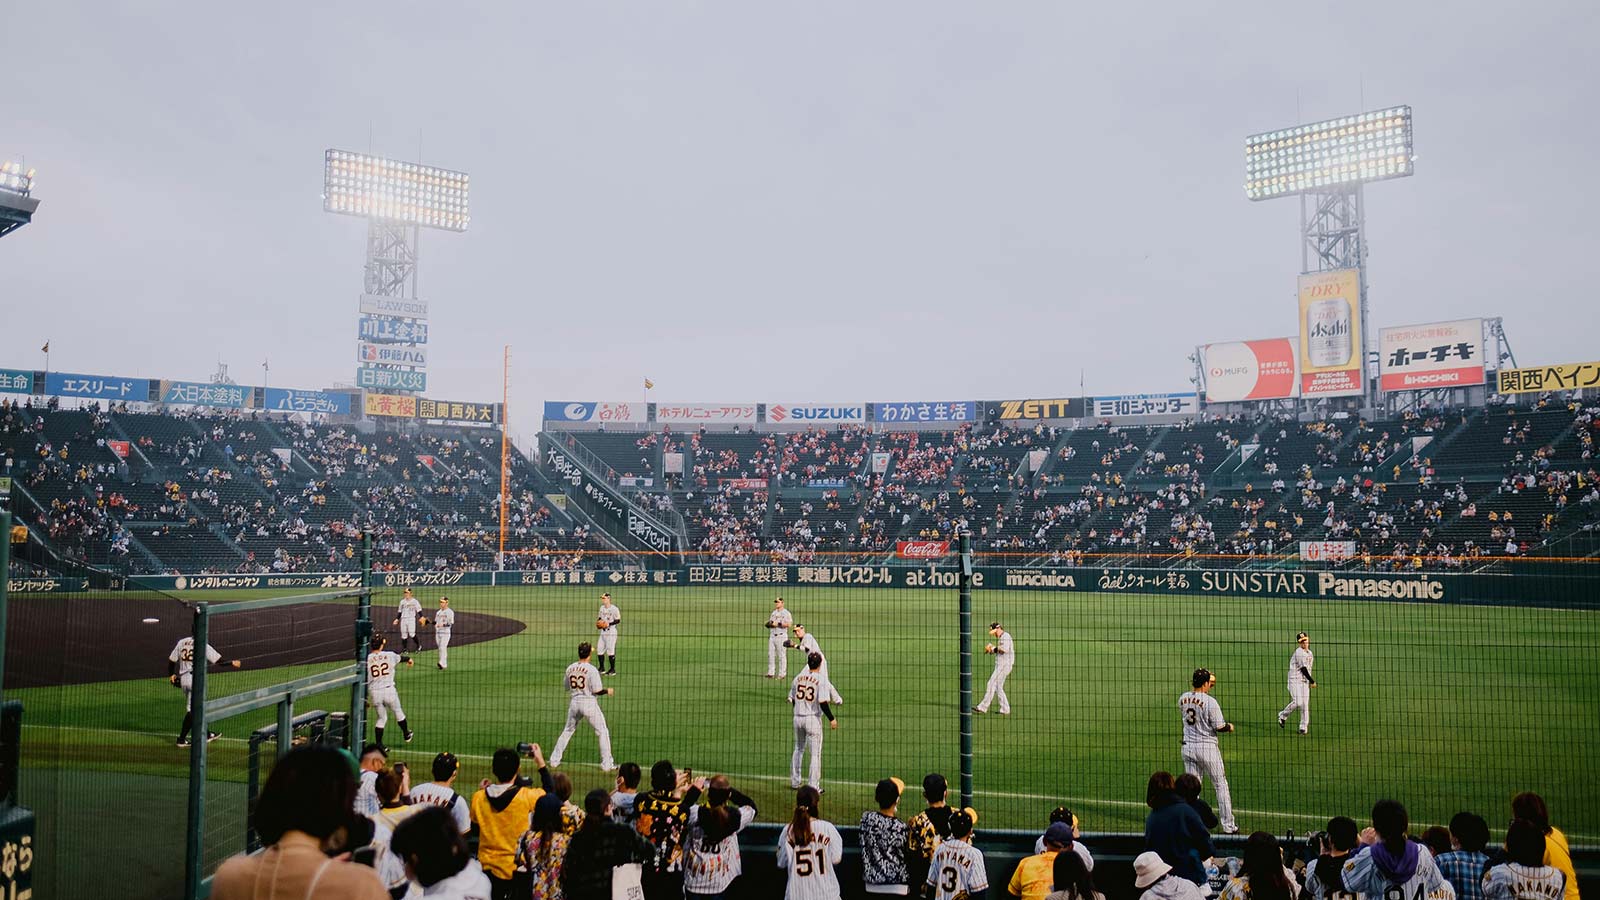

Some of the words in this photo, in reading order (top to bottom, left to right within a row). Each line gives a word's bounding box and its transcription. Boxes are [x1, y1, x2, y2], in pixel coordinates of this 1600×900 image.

[1311, 283, 1343, 297] DRY
[377, 300, 427, 314] LAWSON
[362, 320, 427, 342] 川上塗料
[1311, 318, 1347, 337] Asahi
[379, 349, 425, 363] 伊藤ハム
[1388, 342, 1475, 367] ホーチキ
[362, 370, 424, 389] 日新火災
[1224, 367, 1248, 376] MUFG
[1411, 372, 1459, 384] HOCHIKI
[1500, 365, 1600, 392] 関西ペイン
[0, 374, 29, 390] 生命
[62, 379, 133, 396] エスリード
[171, 384, 243, 405] 大日本塗料
[294, 397, 338, 412] ろうきん
[378, 396, 415, 416] 黄桜
[437, 402, 491, 420] 関西外大
[659, 407, 754, 419] ホテルニューアワジ
[791, 407, 862, 419] SUZUKI
[882, 403, 967, 421] わかさ生活
[1000, 399, 1069, 419] ZETT
[547, 447, 581, 486] 大同生命
[903, 542, 942, 557] Coca-Cola
[190, 576, 260, 588] レンタルのニッケン
[321, 573, 362, 588] オービッ
[396, 572, 465, 586] 日本ハウズイング
[689, 567, 787, 583] 田辺三菱製薬
[798, 566, 892, 584] 東進ハイスクール
[905, 569, 926, 586] at
[930, 565, 984, 586] hoe
[1201, 572, 1308, 594] SUNSTAR
[1318, 573, 1444, 599] Panasonic
[370, 662, 390, 678] 62
[570, 675, 585, 689] 63
[796, 684, 815, 701] 53
[1186, 707, 1196, 725] 3
[795, 849, 825, 877] 51
[942, 866, 958, 893] 3
[1507, 881, 1559, 898] NAKANO
